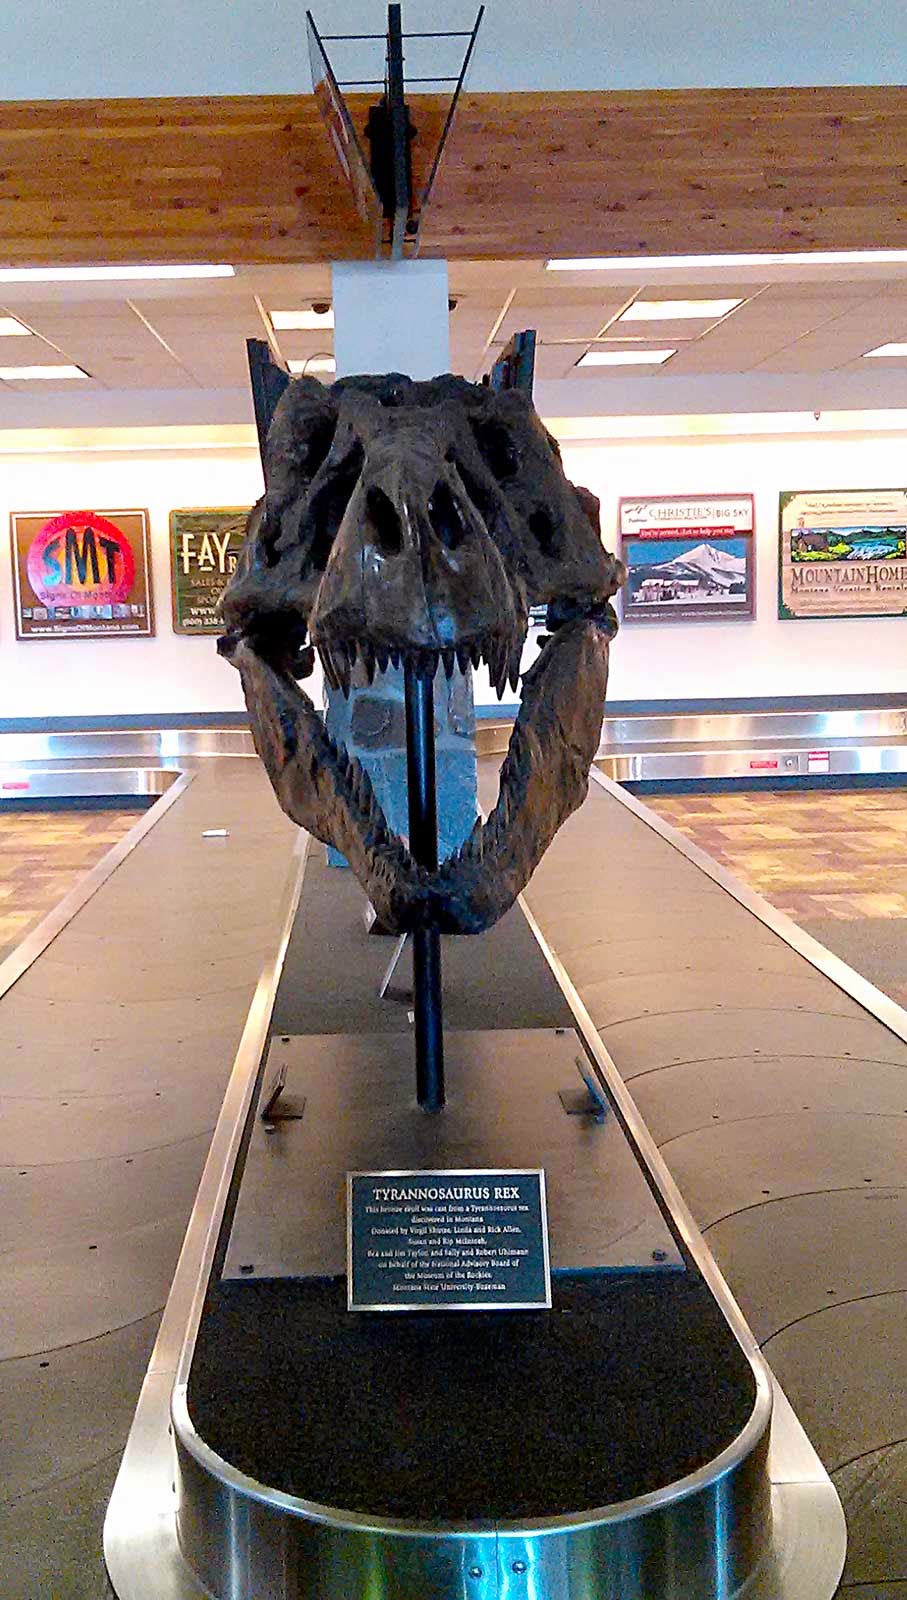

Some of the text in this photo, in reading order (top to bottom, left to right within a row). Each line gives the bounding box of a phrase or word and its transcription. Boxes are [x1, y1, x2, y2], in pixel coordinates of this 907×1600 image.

[648, 507, 750, 518] CHRISTIE'S BIG SKY
[42, 526, 121, 587] SMT
[181, 532, 231, 575] FAY
[372, 1187, 520, 1200] TYRANNOSAURUS REX
[400, 1227, 409, 1235] by
[453, 1226, 473, 1234] Linda
[473, 1226, 486, 1234] and
[428, 1237, 441, 1245] and
[430, 1248, 443, 1256] and
[461, 1247, 475, 1256] and
